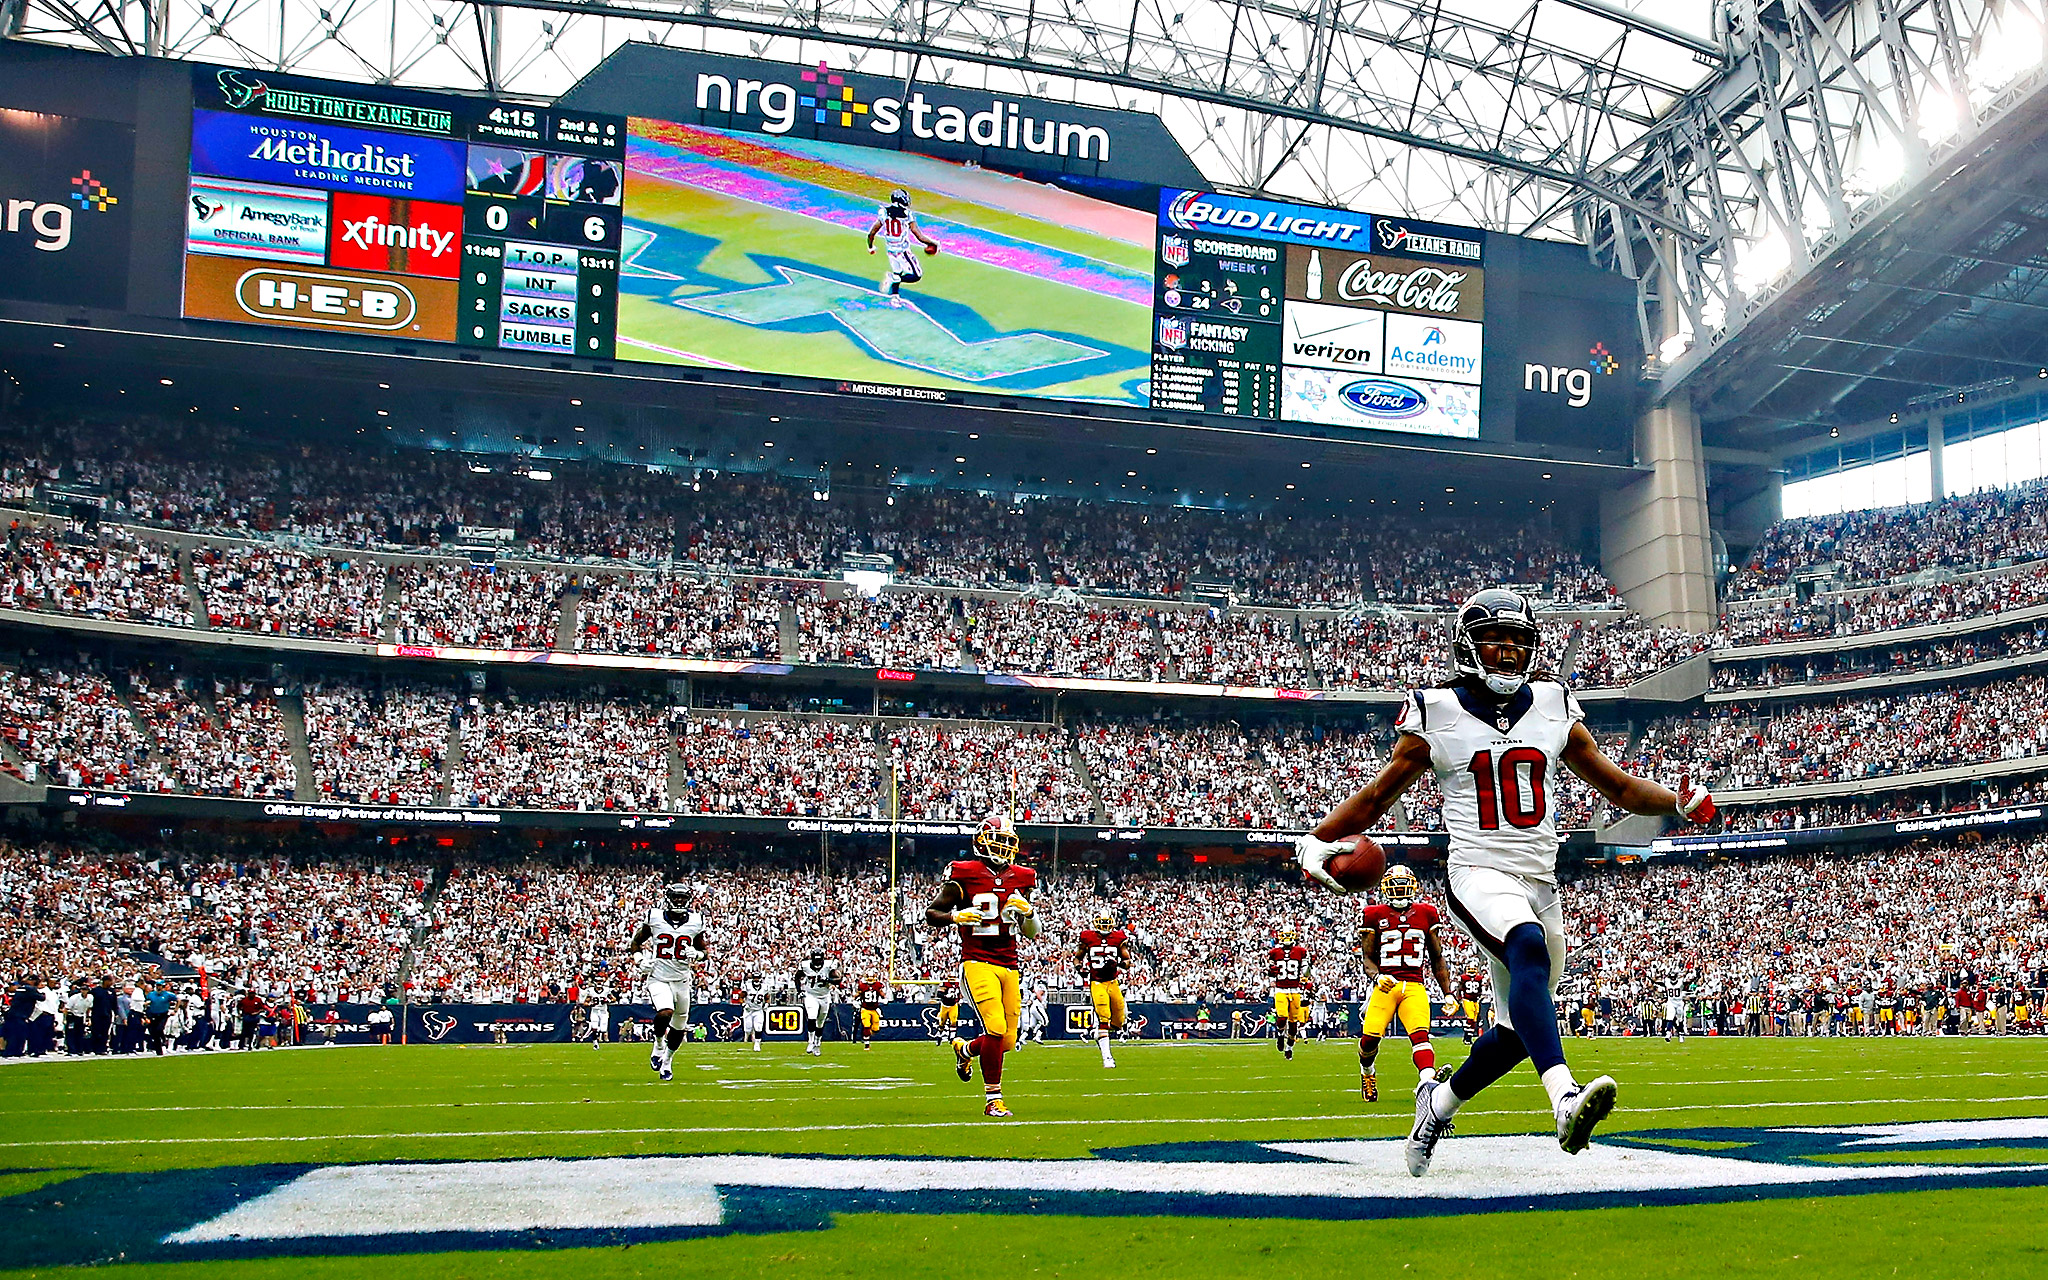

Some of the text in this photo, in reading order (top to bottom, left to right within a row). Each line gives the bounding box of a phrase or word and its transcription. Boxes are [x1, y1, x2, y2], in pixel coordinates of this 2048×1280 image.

[265, 90, 452, 131] HOUSTONTEXANS.COM
[489, 107, 536, 127] 4:15
[695, 71, 1111, 162] nrg stadium
[250, 126, 317, 141] HOUSTON
[493, 126, 539, 140] QUARTER
[559, 118, 585, 132] 2nd
[583, 135, 598, 145] ON
[249, 137, 415, 178] Methodist
[294, 169, 414, 190] LEADING MEDICINE
[0, 198, 73, 252] rg
[240, 206, 323, 227] AmegyBank
[486, 205, 509, 232] 0
[1183, 199, 1362, 241] BUD LIGHT
[213, 228, 300, 246] OFFICIAL BANK
[341, 215, 455, 257] xfinity
[583, 216, 606, 242] 6
[885, 219, 902, 237] 10
[1193, 239, 1277, 261] SCOREBOARD
[1406, 235, 1481, 257] TEXANS RADIO
[515, 249, 569, 267] T.O.P.
[580, 256, 615, 270] 13:11
[1218, 260, 1268, 275] WEEK 1
[475, 272, 603, 298] 0 INT 0
[1337, 258, 1468, 313] Coca-Cola
[259, 279, 399, 319] H-E-B
[1192, 296, 1210, 310] 24
[475, 298, 600, 325] 2 SACKS 1
[473, 325, 600, 350] 0 FUMBLE 0
[1190, 322, 1249, 341] FANTASY
[1190, 338, 1235, 354] KICKING
[1293, 342, 1371, 363] verizon
[1153, 353, 1184, 363] PLAYER
[1391, 346, 1476, 373] Academy
[852, 384, 946, 401] MITSUBISHI ELECTRIC
[1524, 362, 1592, 408] nrg
[1359, 385, 1405, 408] Ford
[1467, 746, 1548, 831] 10
[304, 806, 341, 820] Energy
[1379, 928, 1426, 967] 23
[1276, 959, 1299, 980] 39
[864, 990, 877, 1003] 91
[1668, 988, 1681, 998] 80
[308, 1023, 371, 1032] EXANS
[473, 1022, 555, 1032] TEXANS
[770, 1011, 798, 1031] 40
[880, 1019, 922, 1028] BULL
[1070, 1010, 1091, 1029] 40
